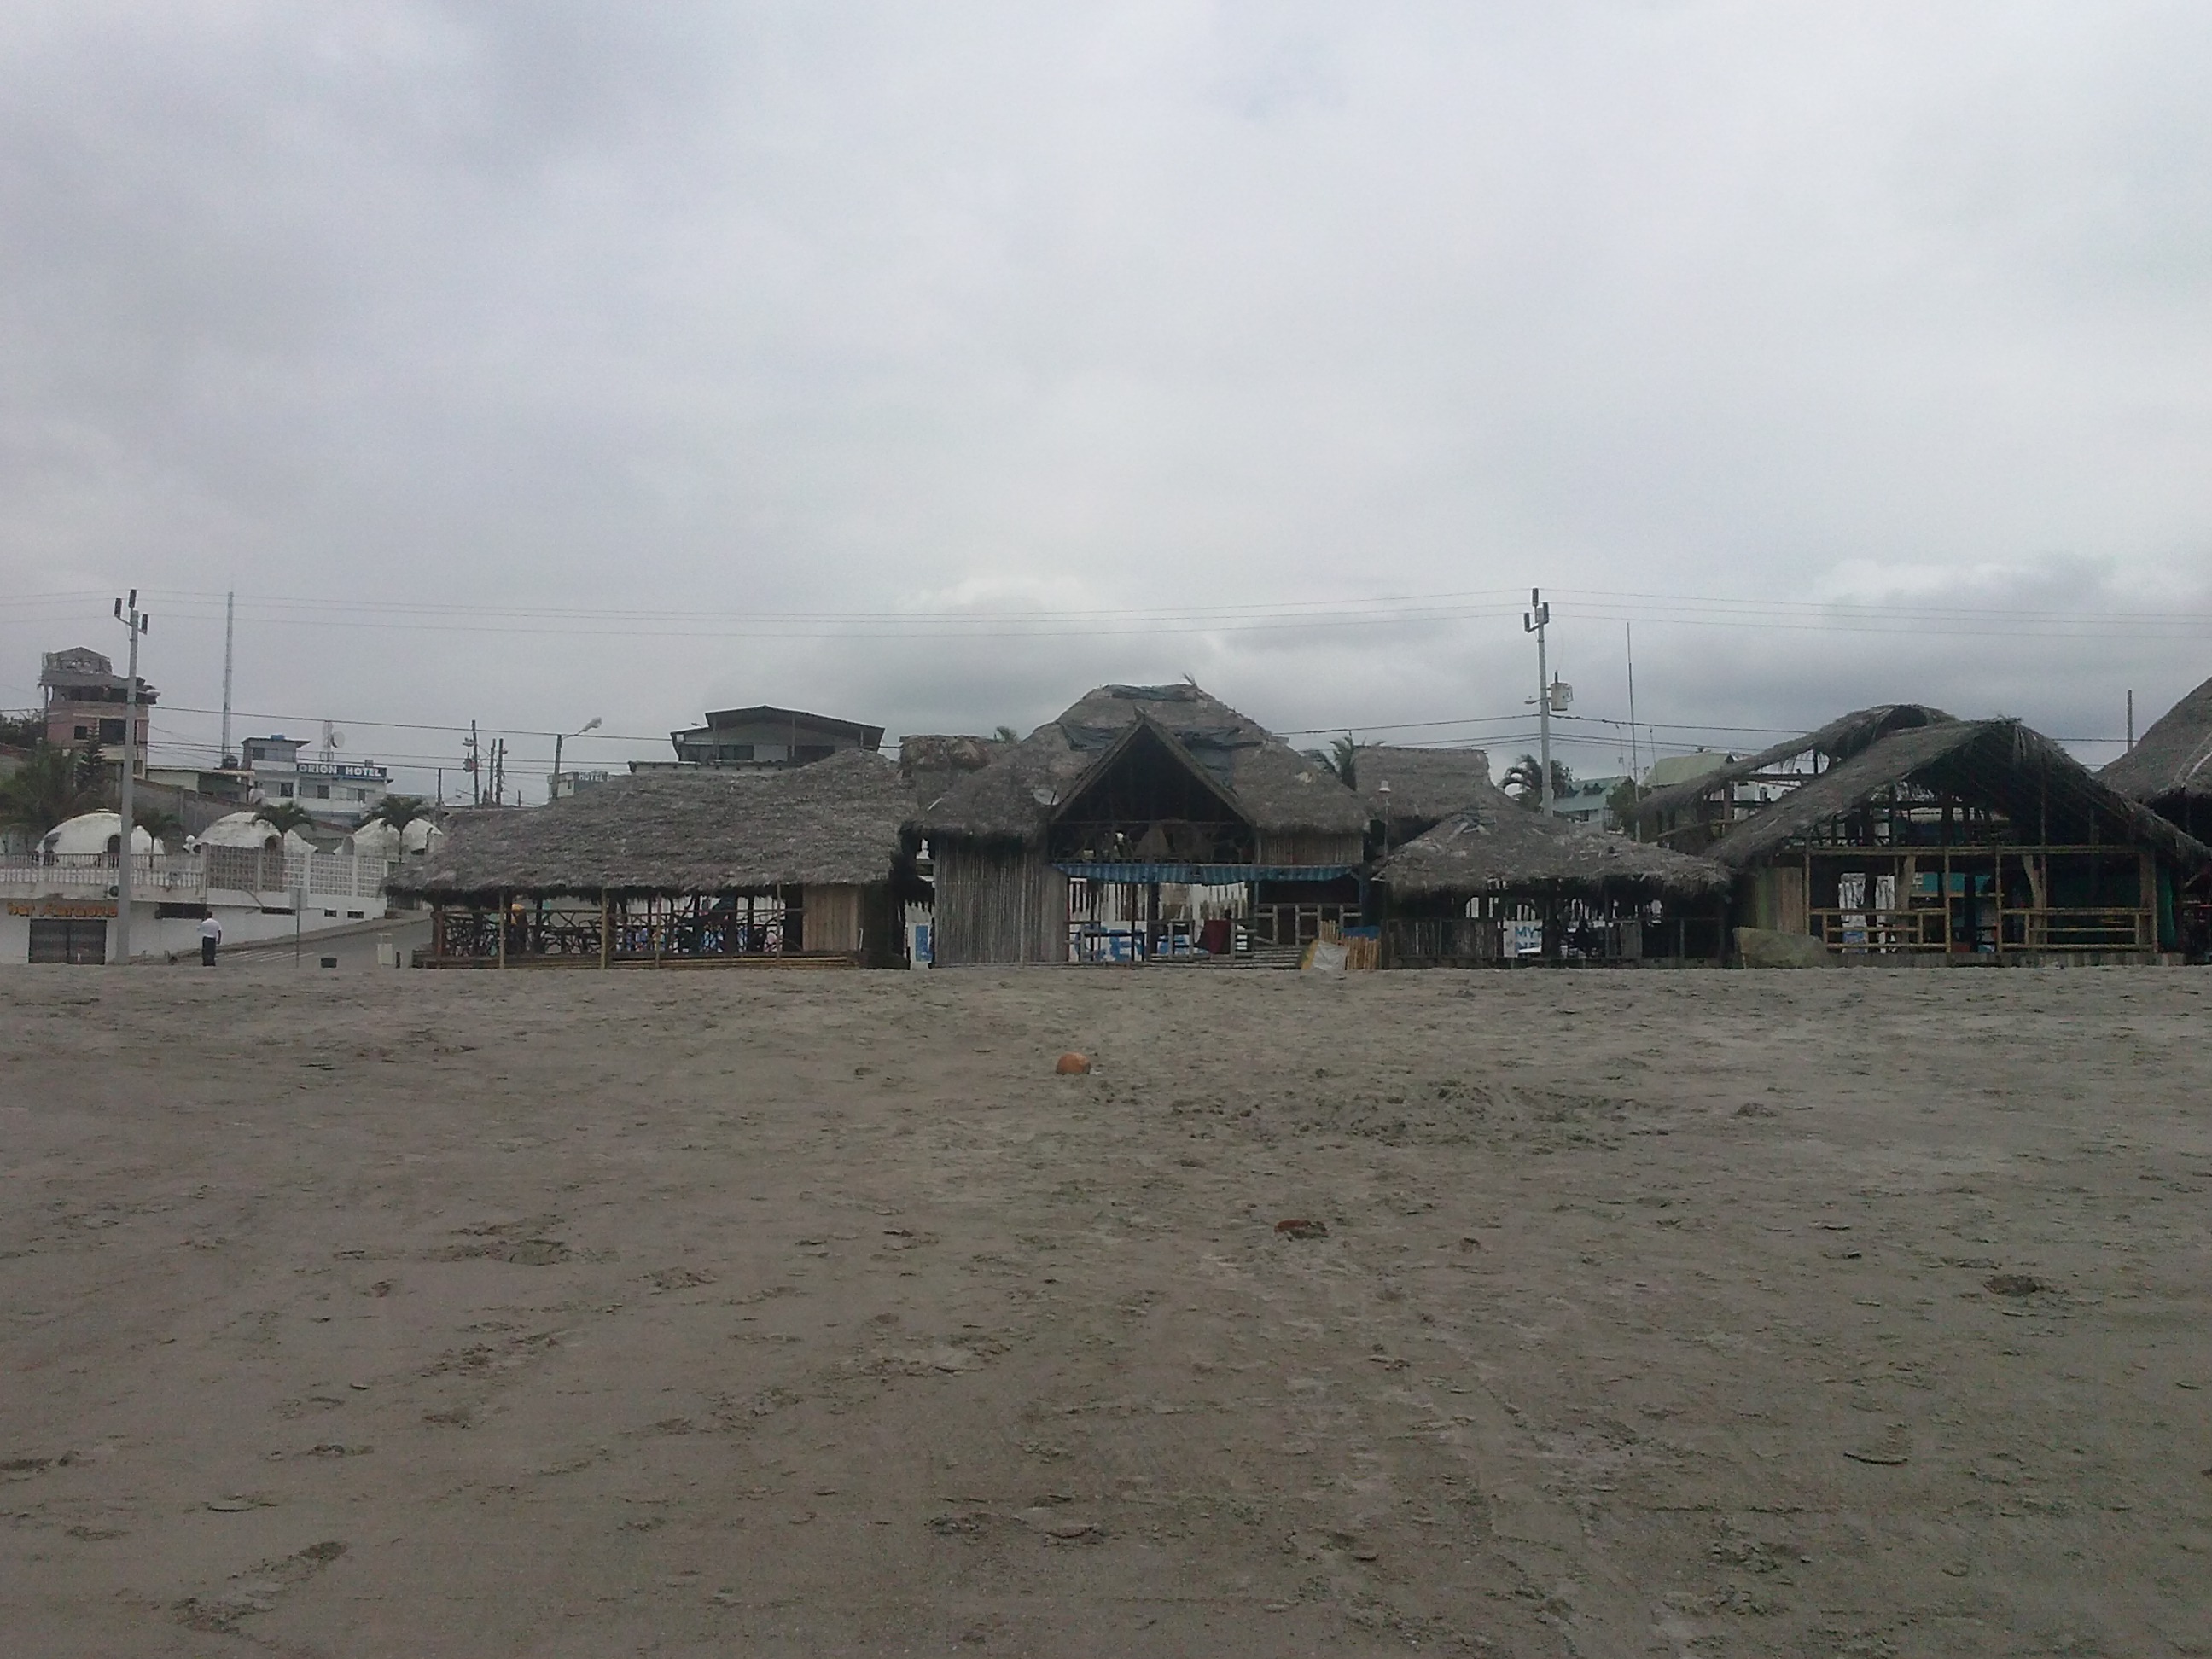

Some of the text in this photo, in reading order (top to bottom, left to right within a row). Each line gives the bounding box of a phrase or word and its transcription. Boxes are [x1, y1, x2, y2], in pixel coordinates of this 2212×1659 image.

[298, 764, 381, 777] ORION HOTEL
[579, 771, 605, 782] HOTEL
